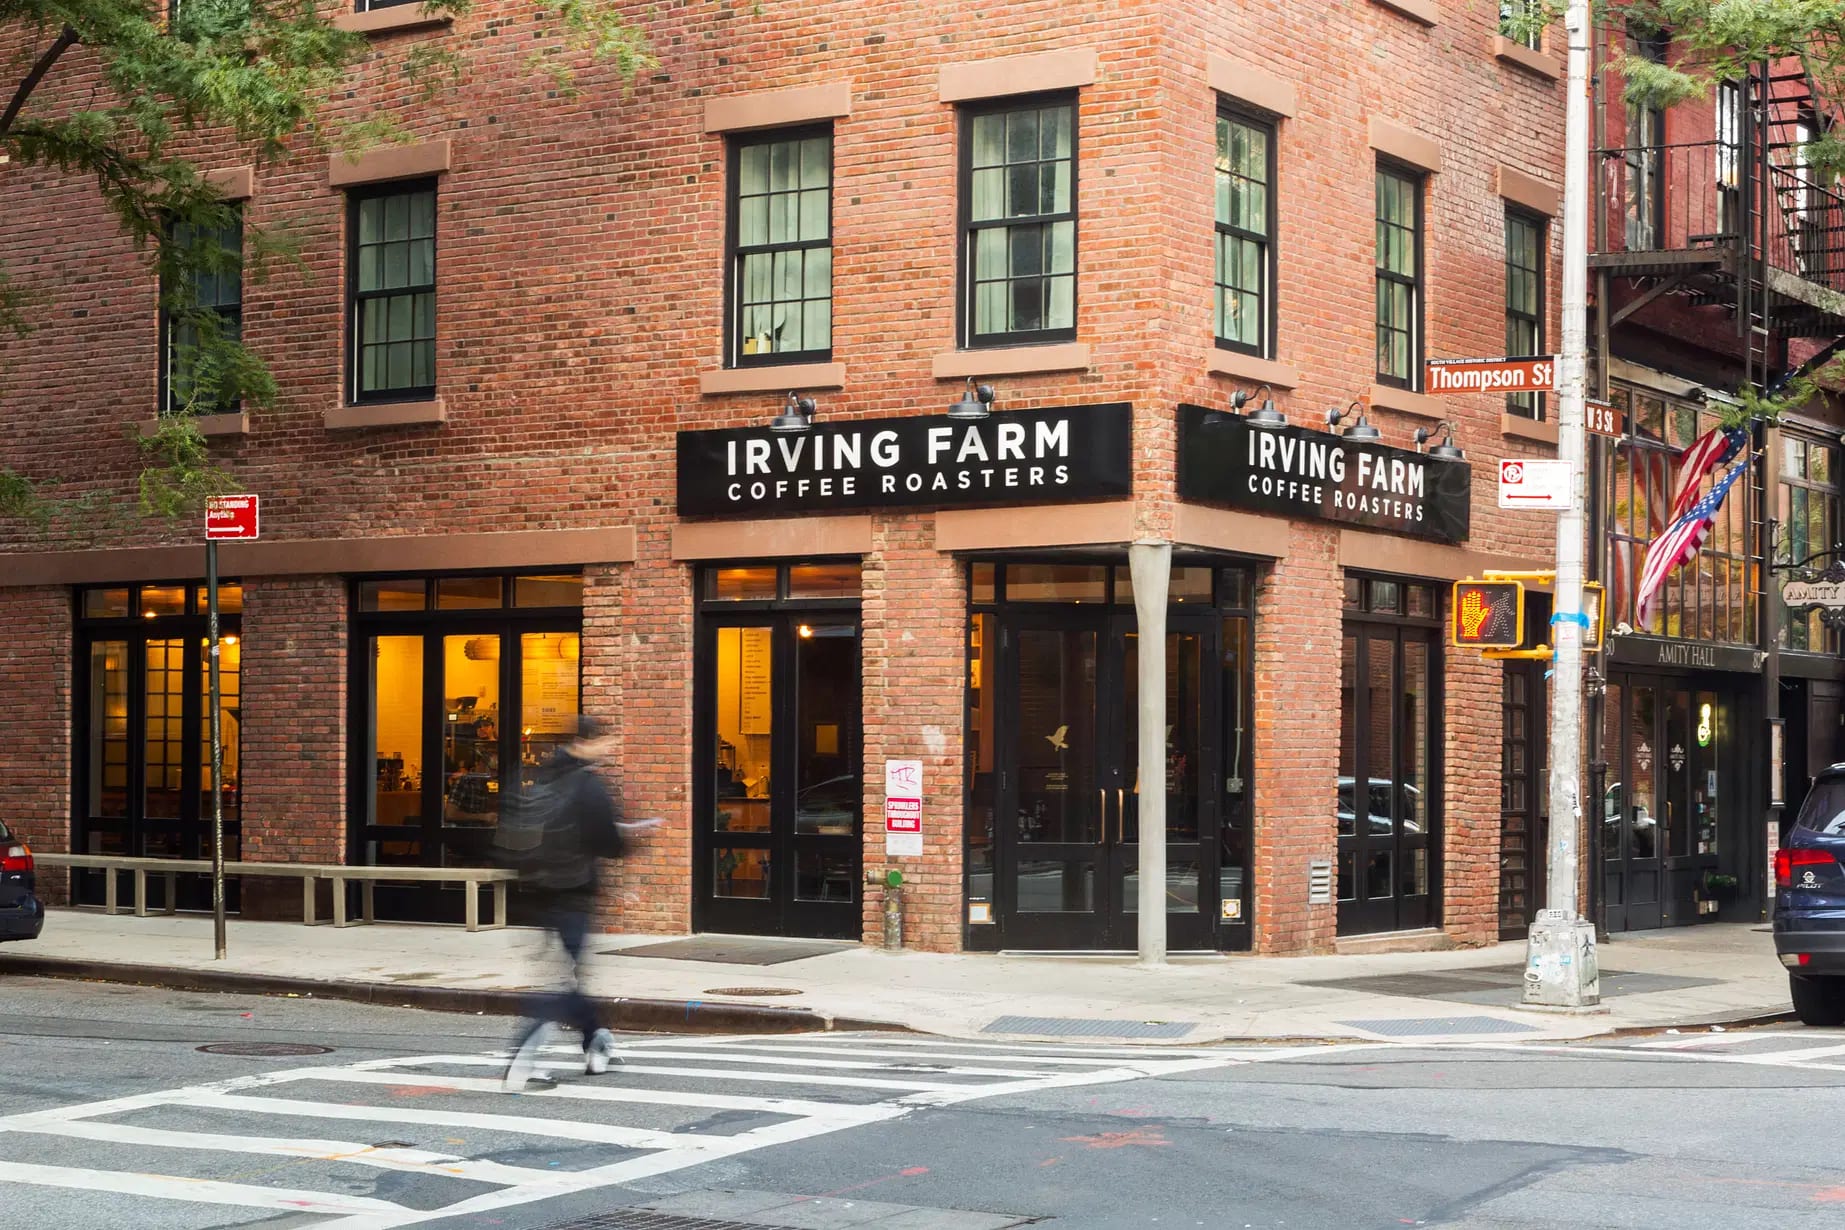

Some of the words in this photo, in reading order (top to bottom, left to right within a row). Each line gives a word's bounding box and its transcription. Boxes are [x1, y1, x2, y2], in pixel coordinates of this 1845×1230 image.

[1430, 367, 1524, 392] Thompson
[1532, 363, 1552, 386] St
[1587, 406, 1595, 429] W
[1596, 408, 1603, 431] 3
[1604, 410, 1614, 433] St
[728, 430, 899, 476] IRVING
[928, 420, 1069, 465] FARM
[1248, 429, 1345, 483] IRVING
[1358, 452, 1425, 498] FARM
[728, 476, 856, 501] COFFEE
[882, 465, 1069, 493] ROASTERS
[1248, 474, 1322, 504] COFFEE
[1334, 490, 1423, 522] ROASTERS
[1786, 586, 1840, 600] AMITY
[1658, 644, 1690, 665] AMITY
[1691, 646, 1716, 667] HALL
